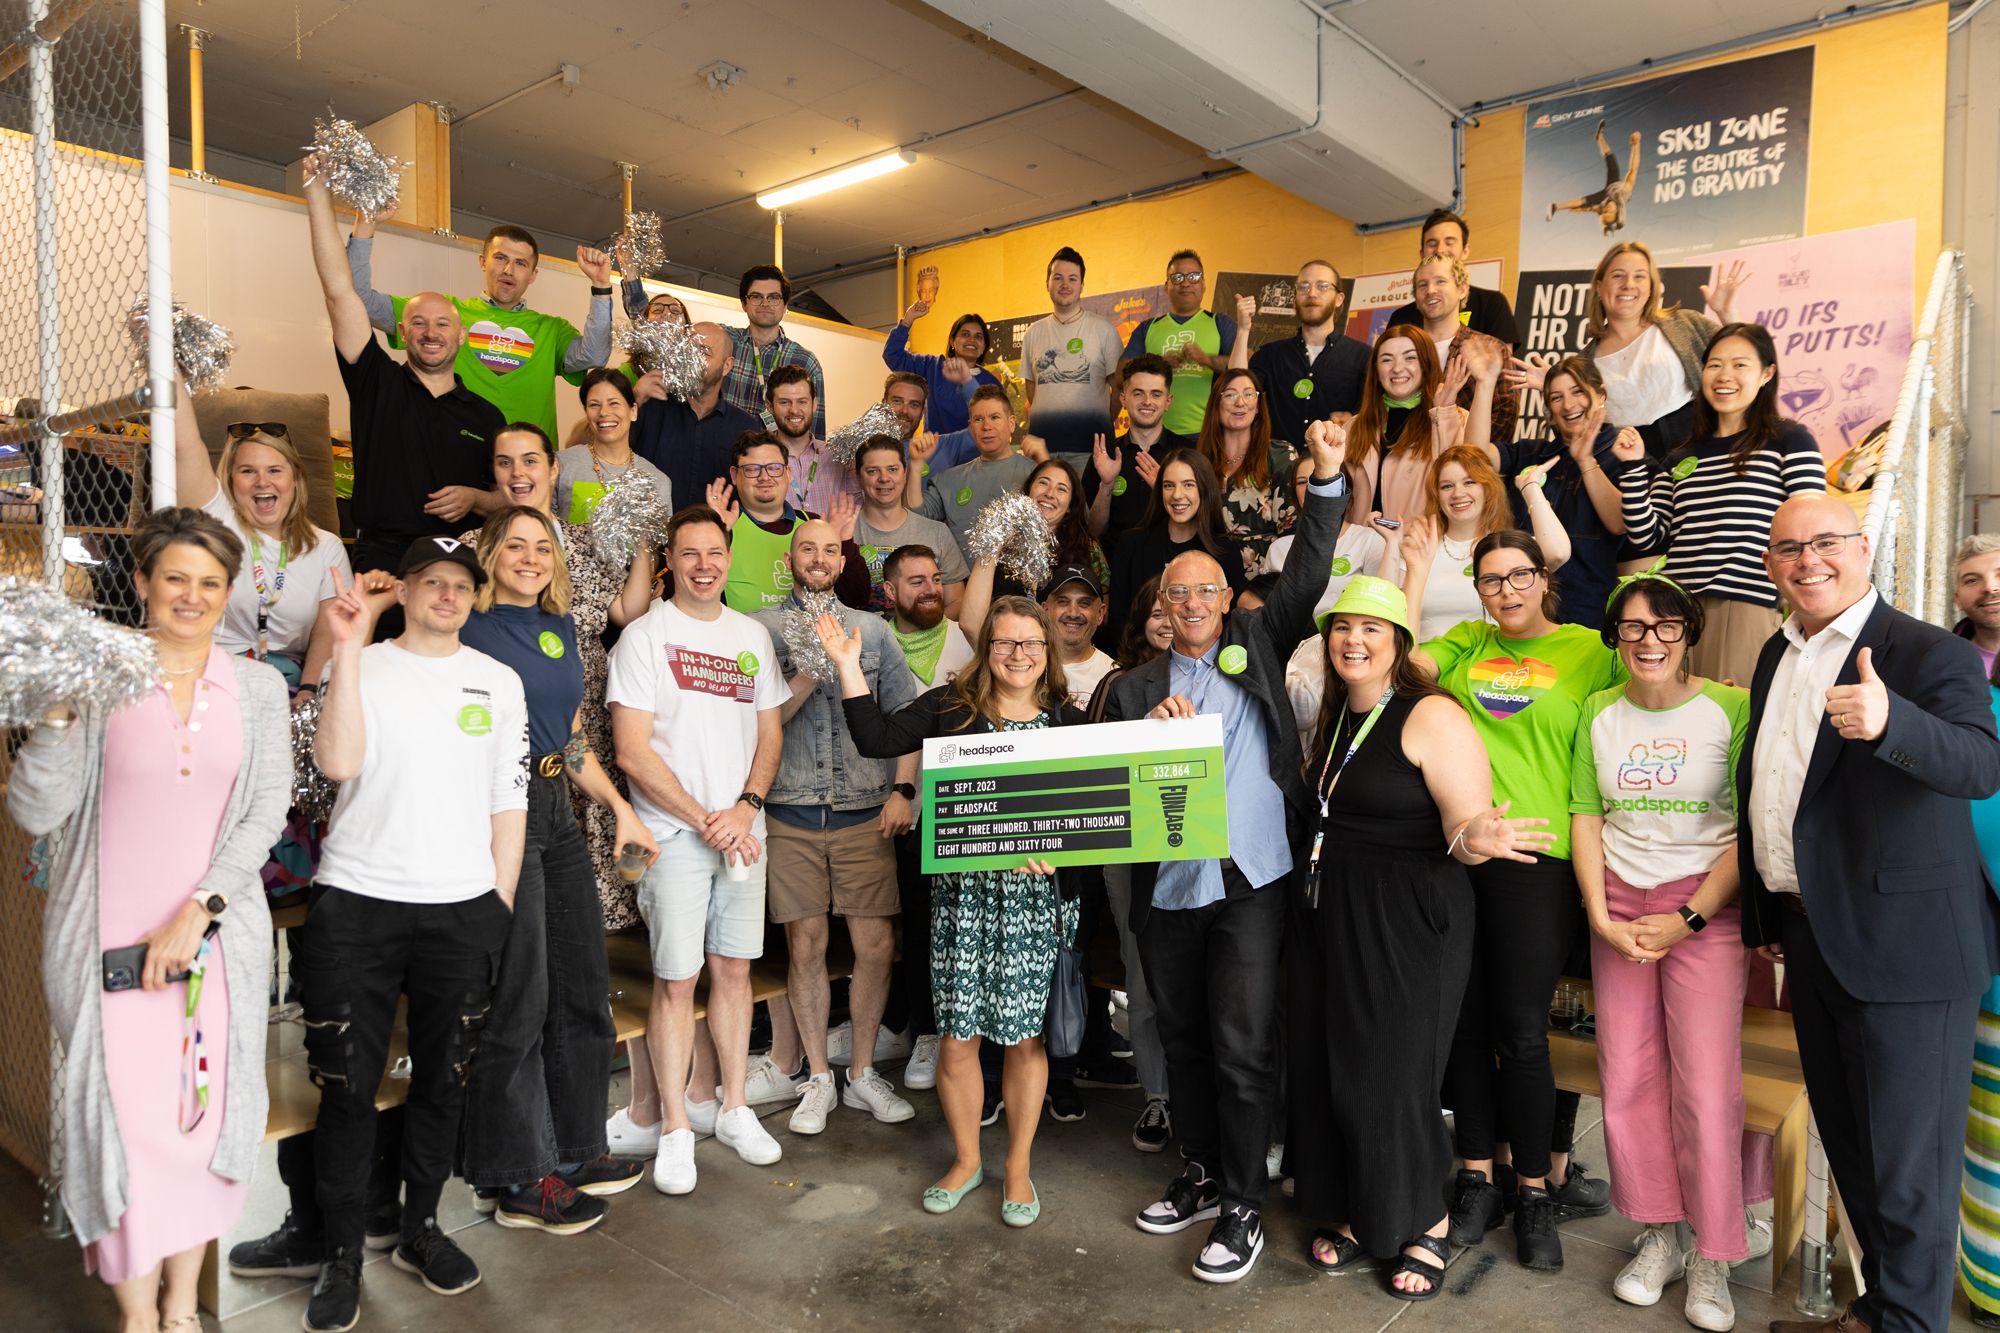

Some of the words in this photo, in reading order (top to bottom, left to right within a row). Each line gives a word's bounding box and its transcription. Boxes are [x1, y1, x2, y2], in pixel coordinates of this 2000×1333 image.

[1657, 121, 1712, 156] SKY
[1718, 106, 1789, 146] ZONE
[1656, 158, 1688, 180] THE
[1691, 147, 1760, 174] CENTRE
[1654, 178, 1686, 203] NO
[1691, 161, 1786, 197] GRAVITY
[1370, 292, 1409, 304] CIRQUE
[1755, 307, 1789, 330] NO
[1798, 300, 1839, 327] IFS
[1527, 317, 1569, 350] HR
[1784, 320, 1887, 356] PUTTS!
[480, 352, 520, 366] headspace
[680, 652, 738, 672] IN-N-OUT
[681, 664, 754, 687] HAMBURGERS
[693, 679, 707, 688] NO
[708, 682, 732, 693] DELAY
[1478, 688, 1530, 703] headspace
[959, 744, 1015, 756] headspace
[938, 785, 950, 793] DATE
[954, 782, 975, 794] SEPT.
[976, 780, 996, 792] 2023
[954, 801, 998, 815] HEADSPACE
[1158, 784, 1188, 832] FUNLAB
[1606, 794, 1709, 816] eadspace
[938, 828, 946, 836] THE
[958, 826, 965, 834] OF
[967, 823, 991, 836] THREE
[1033, 818, 1081, 832] THIRTY-TWO
[1083, 815, 1125, 828] THOUSAND
[937, 844, 960, 856] EIGHT
[961, 842, 997, 854] HUNDRED
[999, 840, 1015, 852] AND
[1017, 839, 1040, 851] SIXTY
[1041, 838, 1063, 850] FOUR
